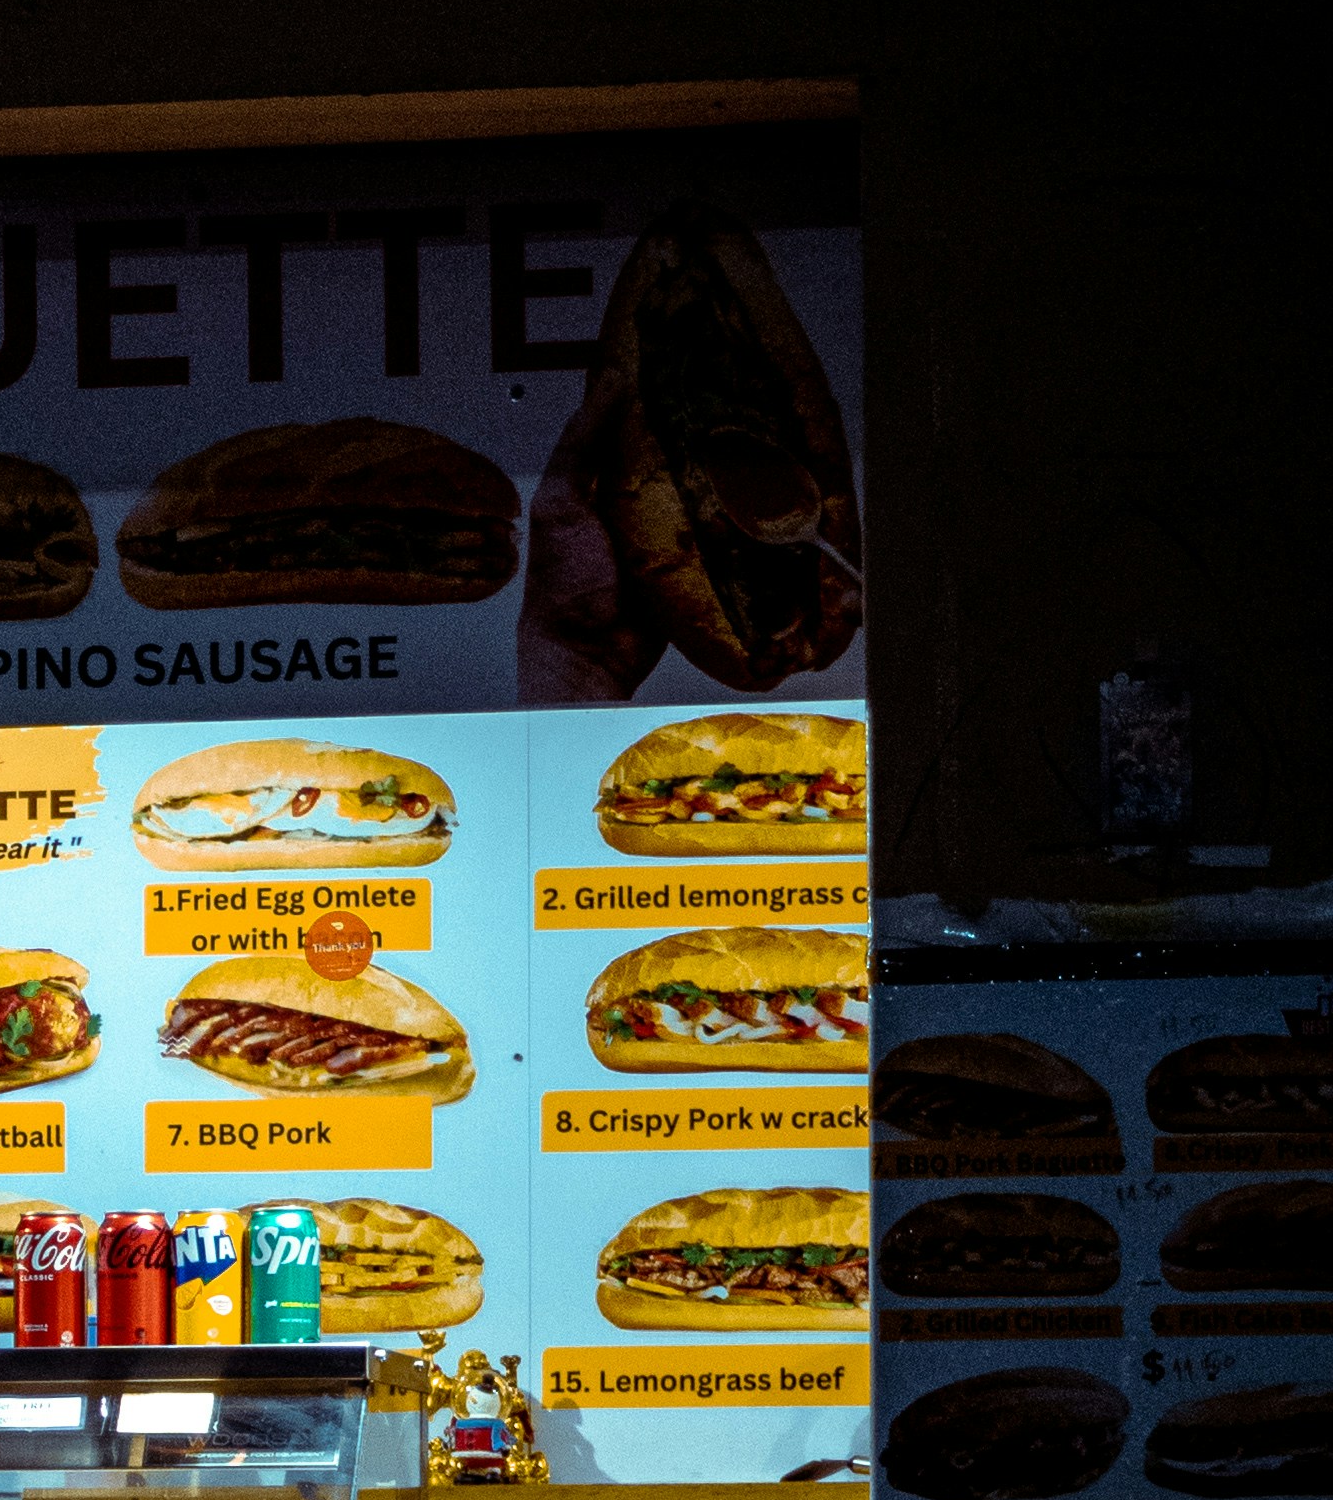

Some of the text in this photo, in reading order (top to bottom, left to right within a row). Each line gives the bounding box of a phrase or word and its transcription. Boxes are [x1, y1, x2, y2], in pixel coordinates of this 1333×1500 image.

[133, 636, 399, 686] SAUSAGE
[41, 836, 61, 859] it
[255, 887, 305, 918] Egg
[312, 884, 417, 911] Omlete
[543, 884, 844, 912] 2. Grilled lemongrass
[191, 931, 219, 951] or
[227, 926, 287, 951] with
[167, 1121, 331, 1149] 7. BBQ Pork
[556, 1113, 580, 1133] 8.
[589, 1110, 679, 1137] Crispy
[689, 1108, 753, 1130] Pork
[762, 1114, 782, 1129] w
[251, 1226, 320, 1275] Spri
[551, 1366, 845, 1399] 15. Lemongrass beef
